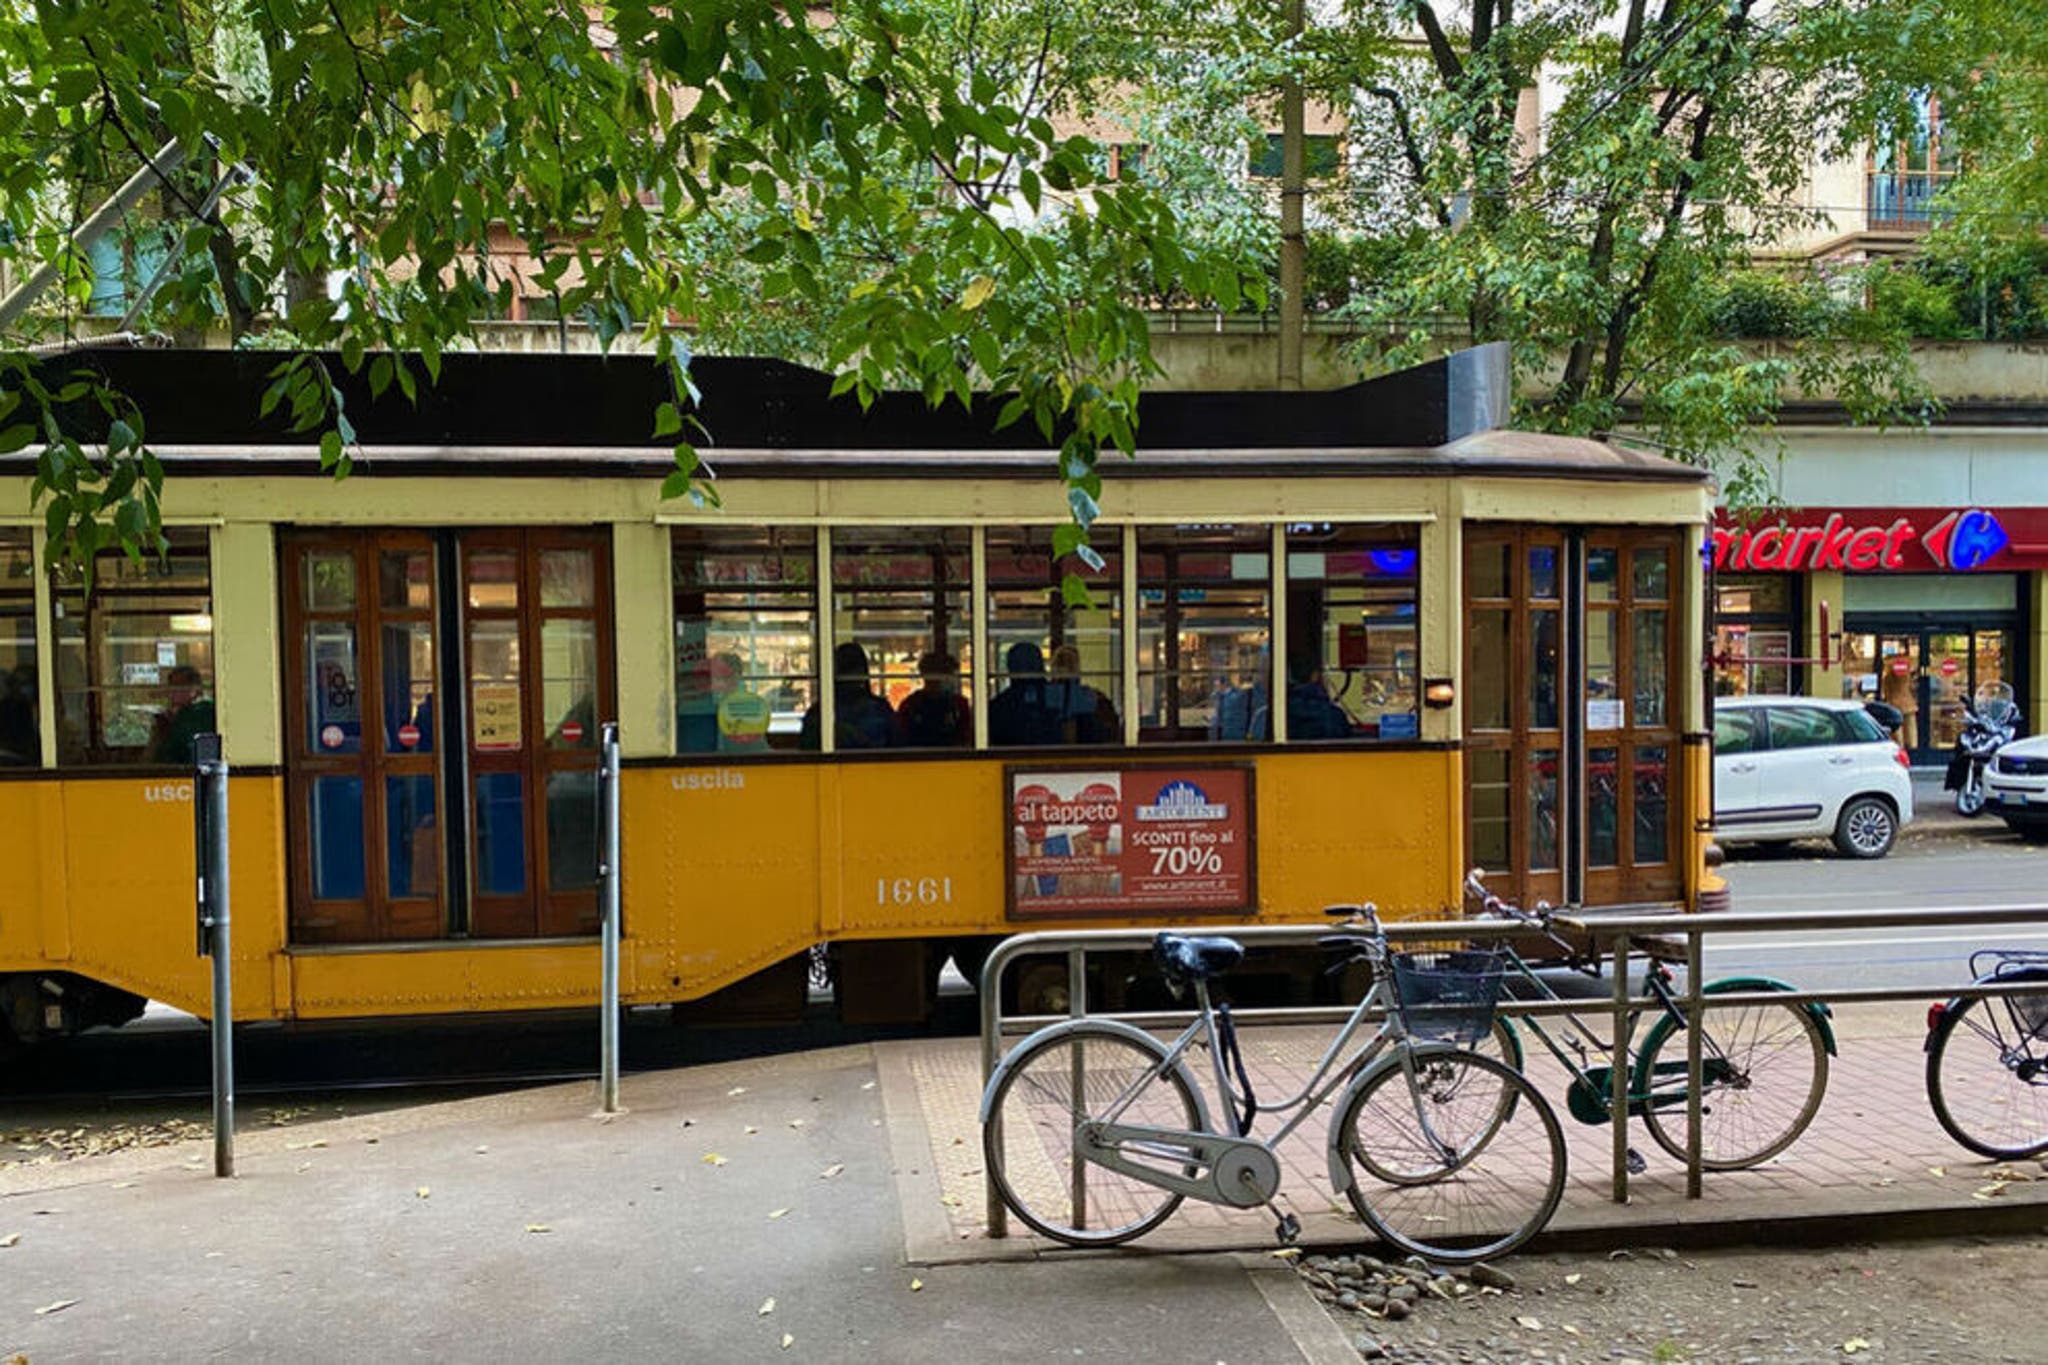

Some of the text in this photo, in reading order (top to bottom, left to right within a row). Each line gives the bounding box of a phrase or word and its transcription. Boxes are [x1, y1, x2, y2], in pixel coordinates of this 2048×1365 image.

[1711, 512, 1917, 571] market
[670, 767, 745, 790] uscita
[144, 784, 191, 802] usc
[1018, 802, 1118, 825] al tappeto
[1131, 829, 1235, 846] SCONTI fino al
[1149, 846, 1223, 875] 70%
[878, 877, 952, 905] 1661
